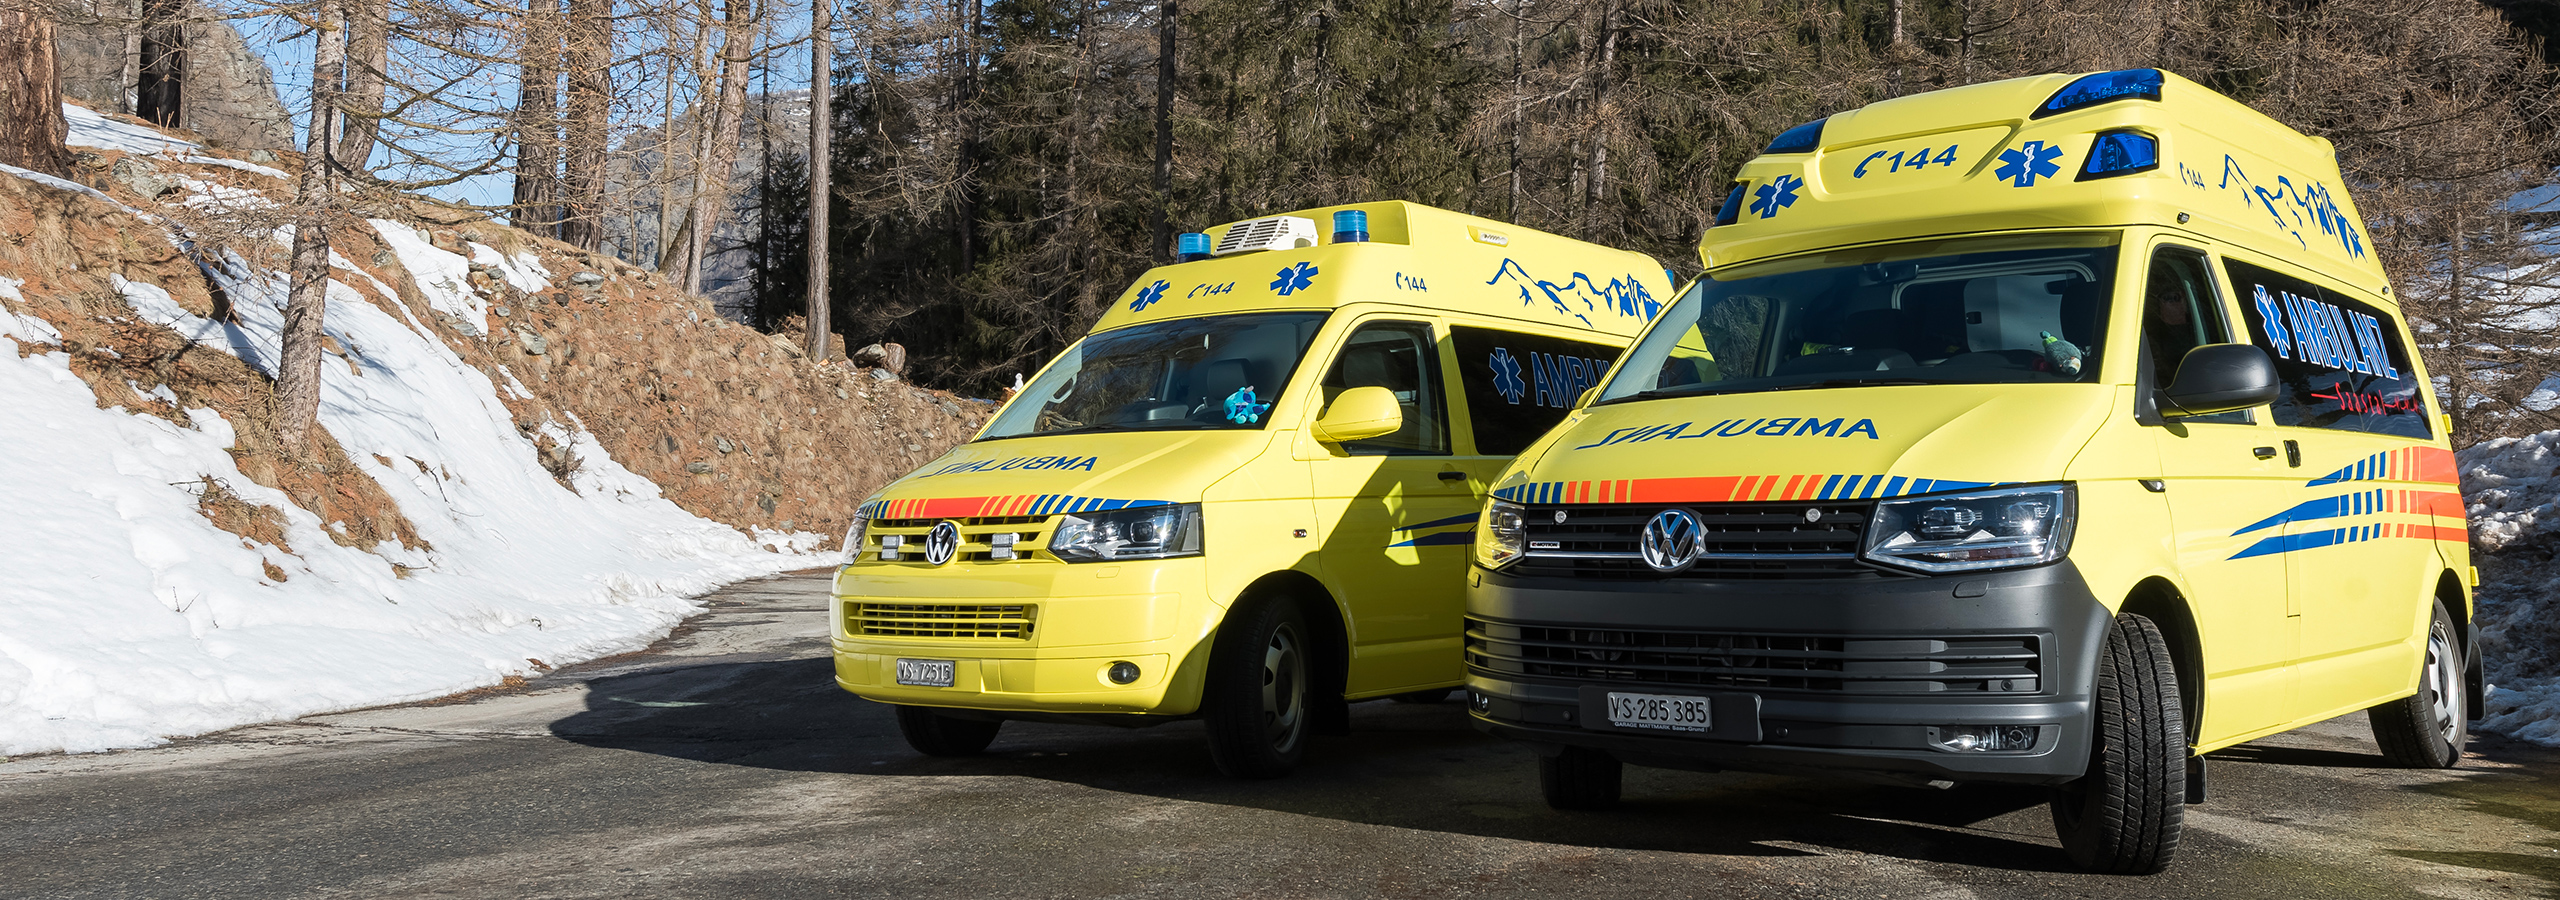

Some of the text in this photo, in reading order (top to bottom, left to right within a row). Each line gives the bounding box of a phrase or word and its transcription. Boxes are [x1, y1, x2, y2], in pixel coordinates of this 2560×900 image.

[1887, 144, 1958, 173] 144
[2186, 167, 2206, 191] 144
[1203, 281, 1236, 297] 144
[1404, 275, 1427, 293] 144
[2281, 290, 2399, 381] AMBULANZ
